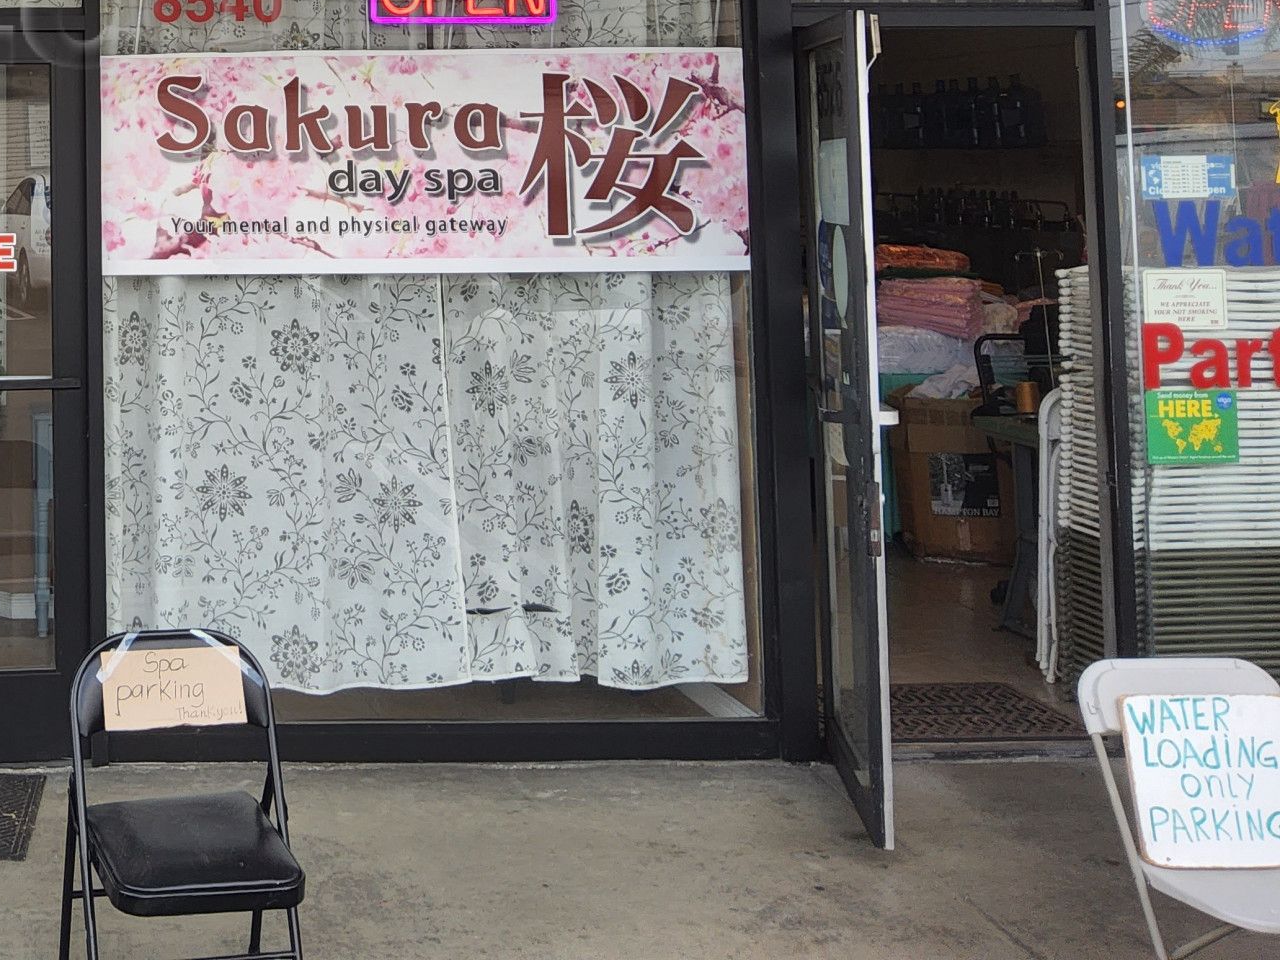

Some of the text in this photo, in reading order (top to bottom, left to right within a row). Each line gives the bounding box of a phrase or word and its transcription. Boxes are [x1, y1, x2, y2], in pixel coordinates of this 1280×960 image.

[157, 75, 504, 152] Sakura
[519, 71, 706, 239] 桜
[328, 160, 501, 201] day spa
[171, 216, 507, 237] Your mental and physical gateway
[1153, 278, 1183, 290] Thank
[143, 652, 189, 678] Spa
[115, 680, 205, 717] parking
[176, 706, 214, 721] Thank
[1127, 697, 1230, 736] WATER
